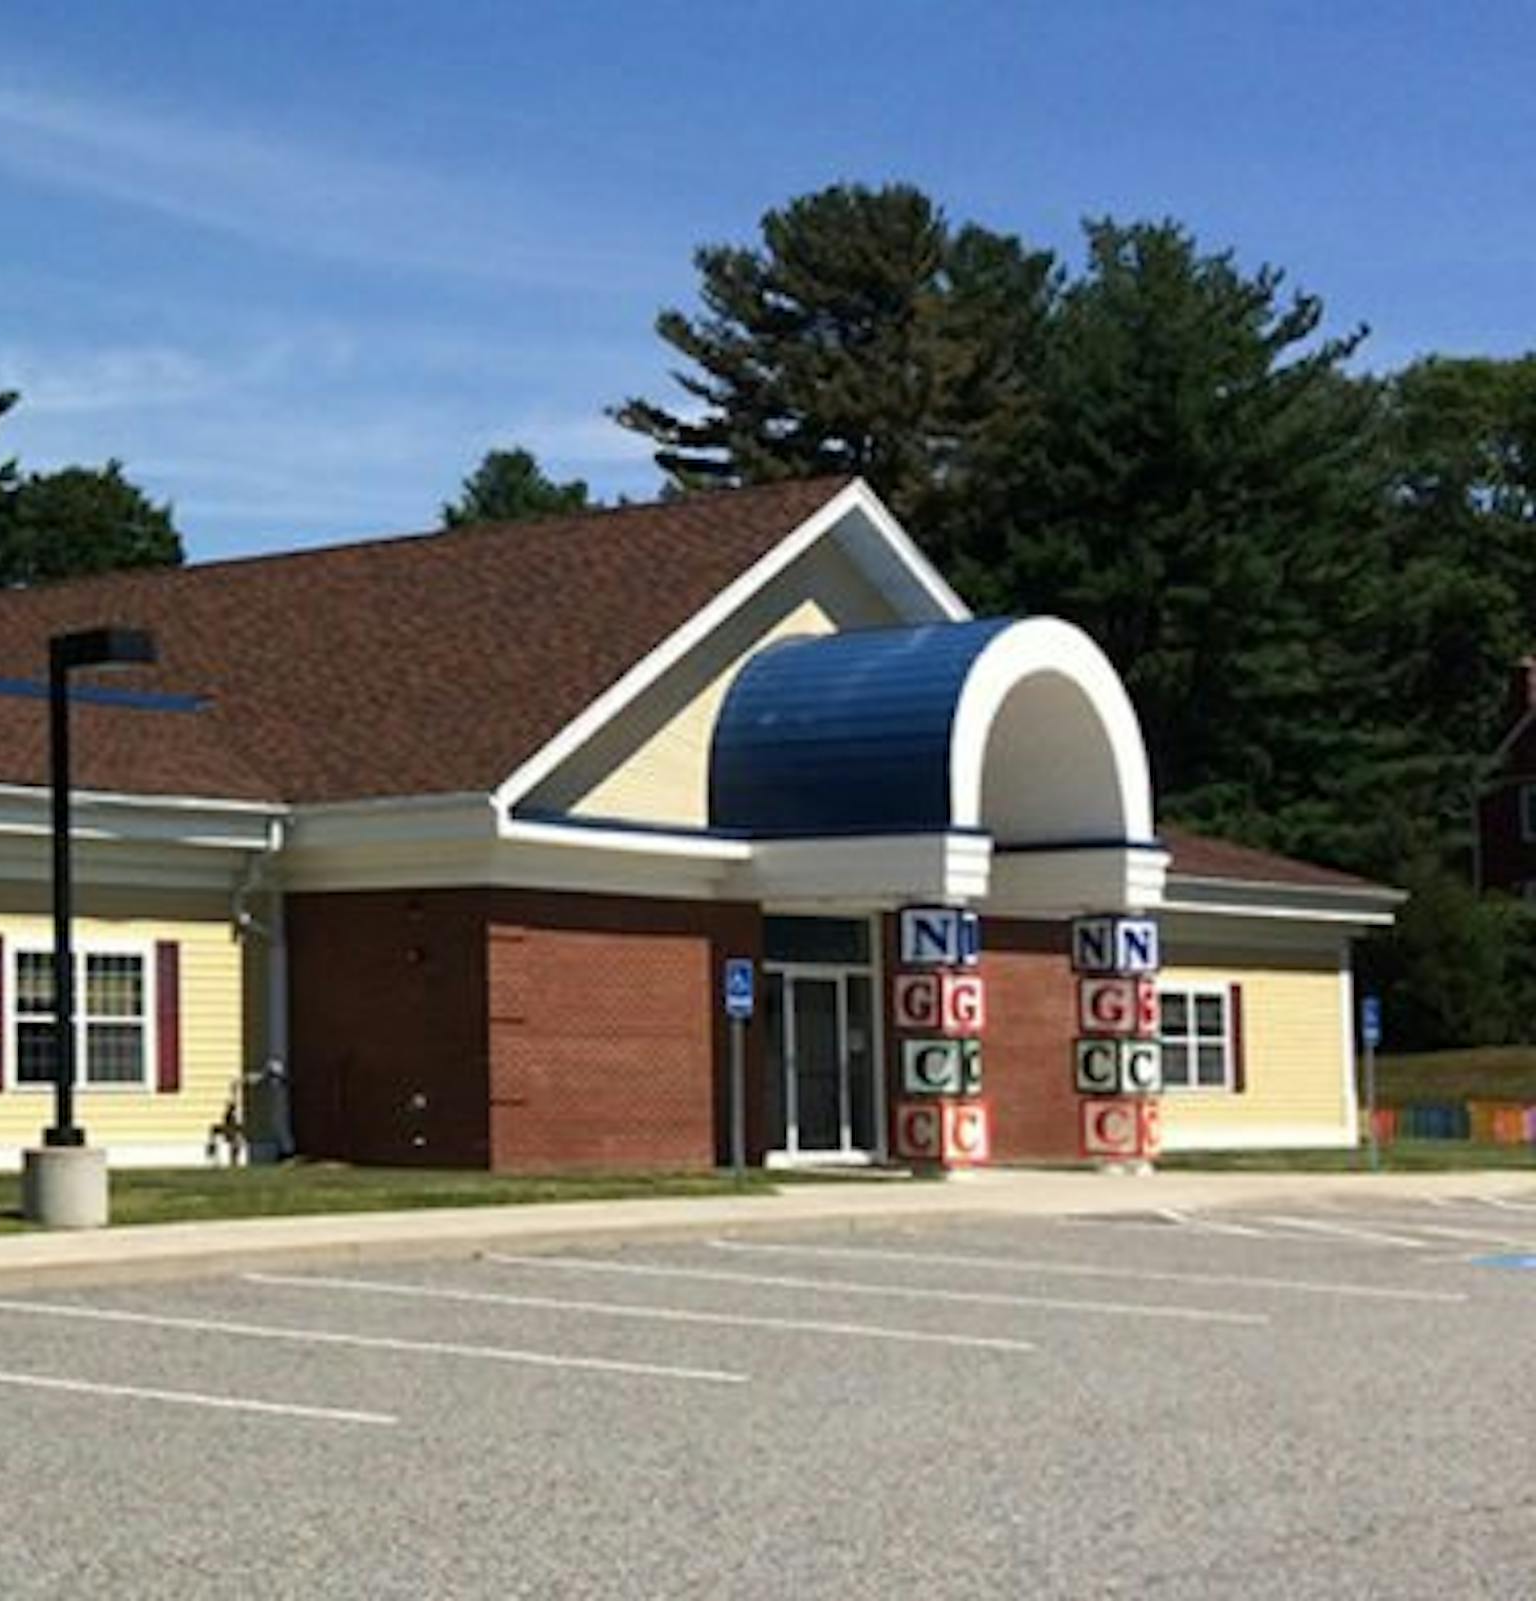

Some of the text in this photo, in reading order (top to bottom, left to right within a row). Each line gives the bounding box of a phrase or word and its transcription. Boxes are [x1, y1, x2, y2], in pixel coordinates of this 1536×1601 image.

[913, 919, 950, 957] N
[1079, 927, 1109, 965] N
[1123, 931, 1151, 964] N
[903, 984, 932, 1019] G
[952, 985, 975, 1023] G
[1092, 986, 1126, 1023] G
[915, 1047, 951, 1087] C
[1082, 1047, 1112, 1082] C
[1131, 1051, 1151, 1084] C
[907, 1111, 932, 1150] C
[954, 1112, 977, 1152] C
[1094, 1109, 1129, 1146] C
